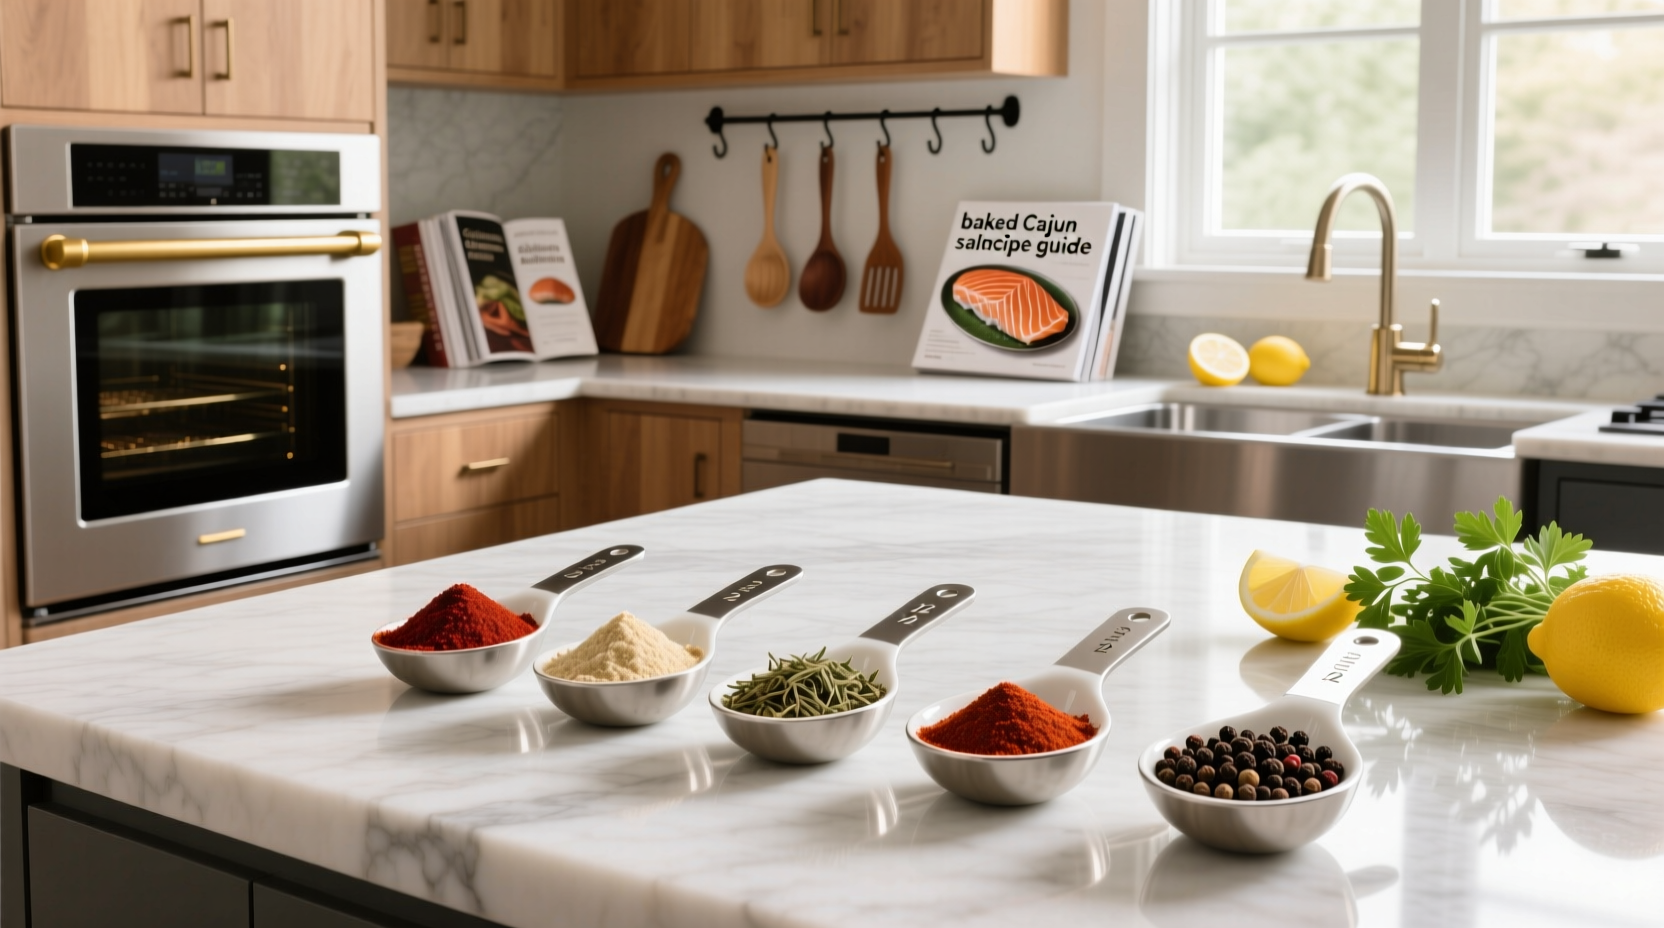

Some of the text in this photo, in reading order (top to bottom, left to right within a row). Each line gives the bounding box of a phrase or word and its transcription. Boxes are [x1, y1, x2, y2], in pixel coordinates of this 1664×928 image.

[961, 212, 1077, 237] baked Cajun
[1036, 236, 1092, 259] guide
